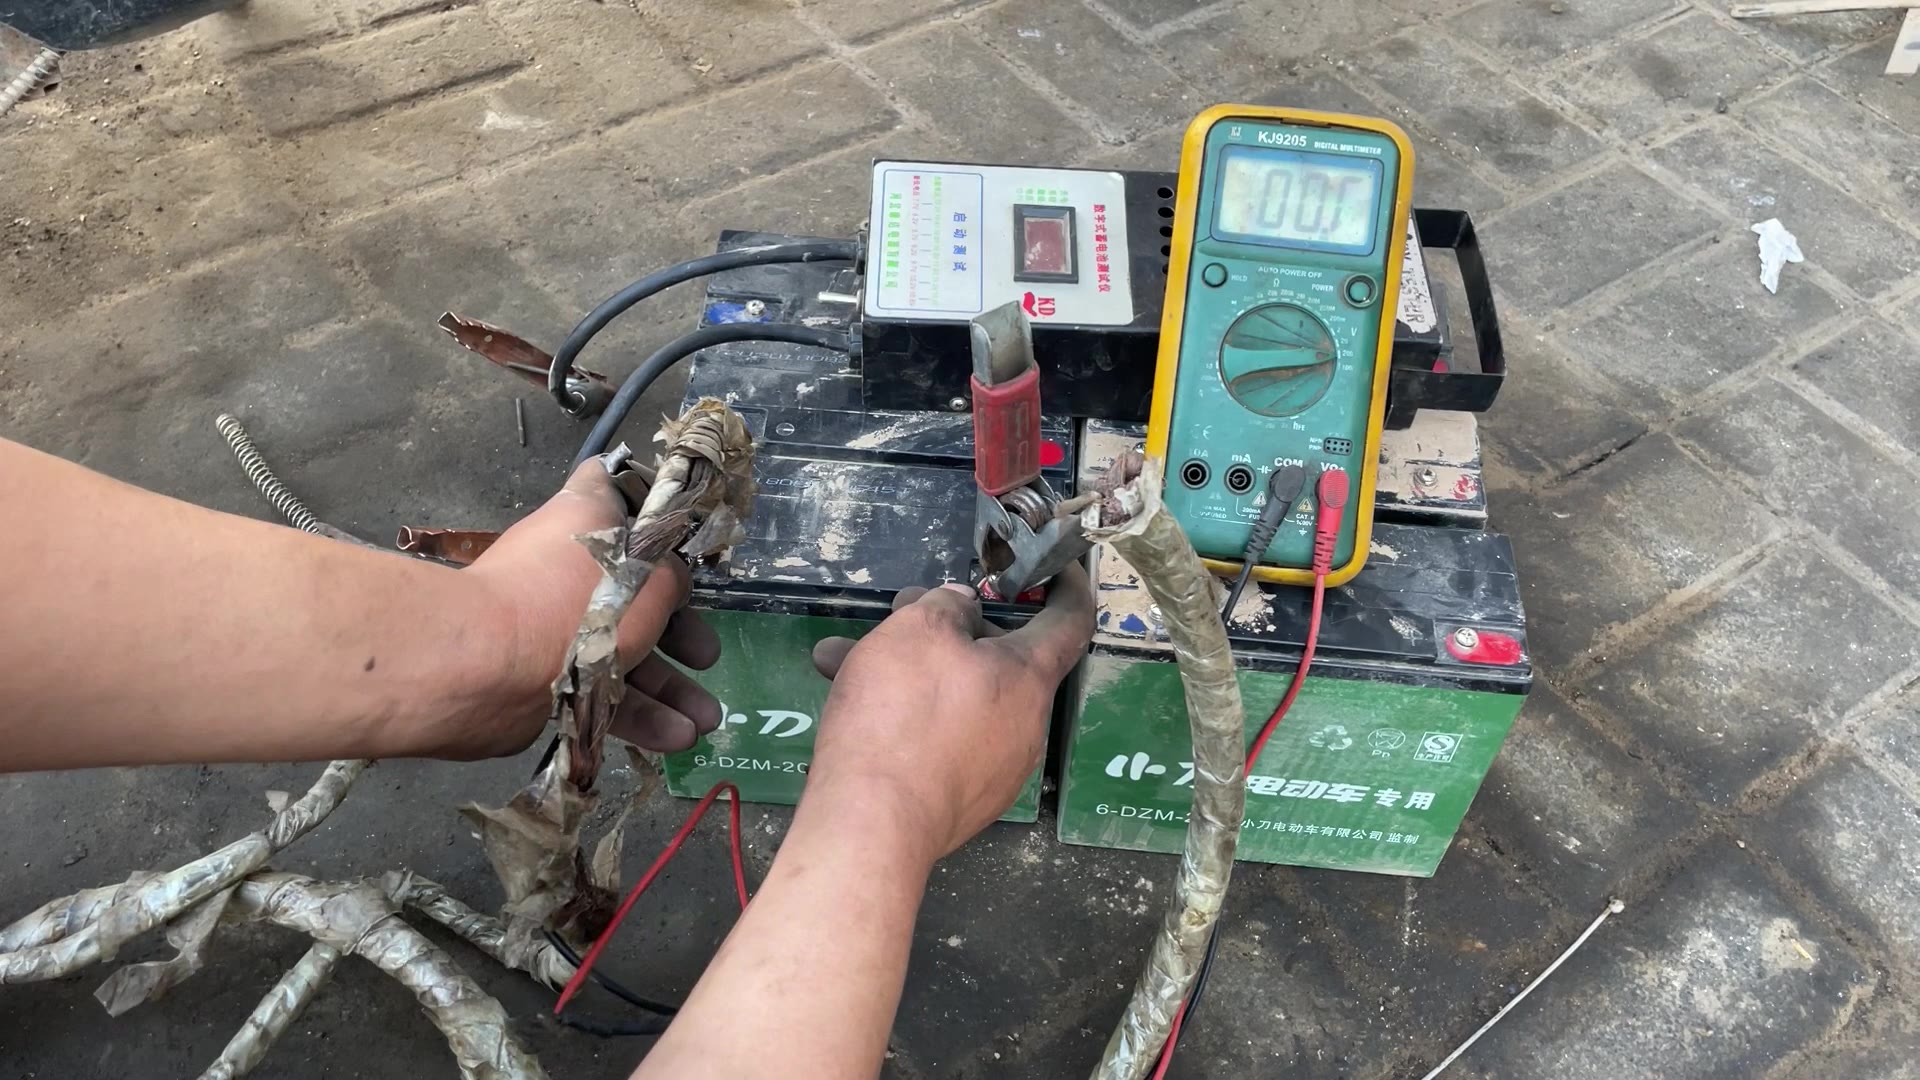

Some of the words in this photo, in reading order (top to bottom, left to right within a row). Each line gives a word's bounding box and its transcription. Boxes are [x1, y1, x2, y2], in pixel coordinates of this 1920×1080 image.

[1257, 131, 1308, 148] KJ9205
[1314, 141, 1339, 151] DIGITAL
[1340, 143, 1382, 155] MULTIMETER
[952, 211, 967, 272] 启动测试
[1093, 204, 1111, 293] 数字式蓄电池测试仪
[1258, 266, 1279, 274] AUTO
[1280, 268, 1307, 277] POWER
[1311, 283, 1334, 292] POWER
[1037, 297, 1056, 317] KD
[1351, 327, 1358, 336] V
[1231, 453, 1252, 464] mA
[1274, 457, 1304, 468] COM
[1241, 819, 1383, 841] 小刀电动车有限公司
[1386, 832, 1420, 844] 监制
